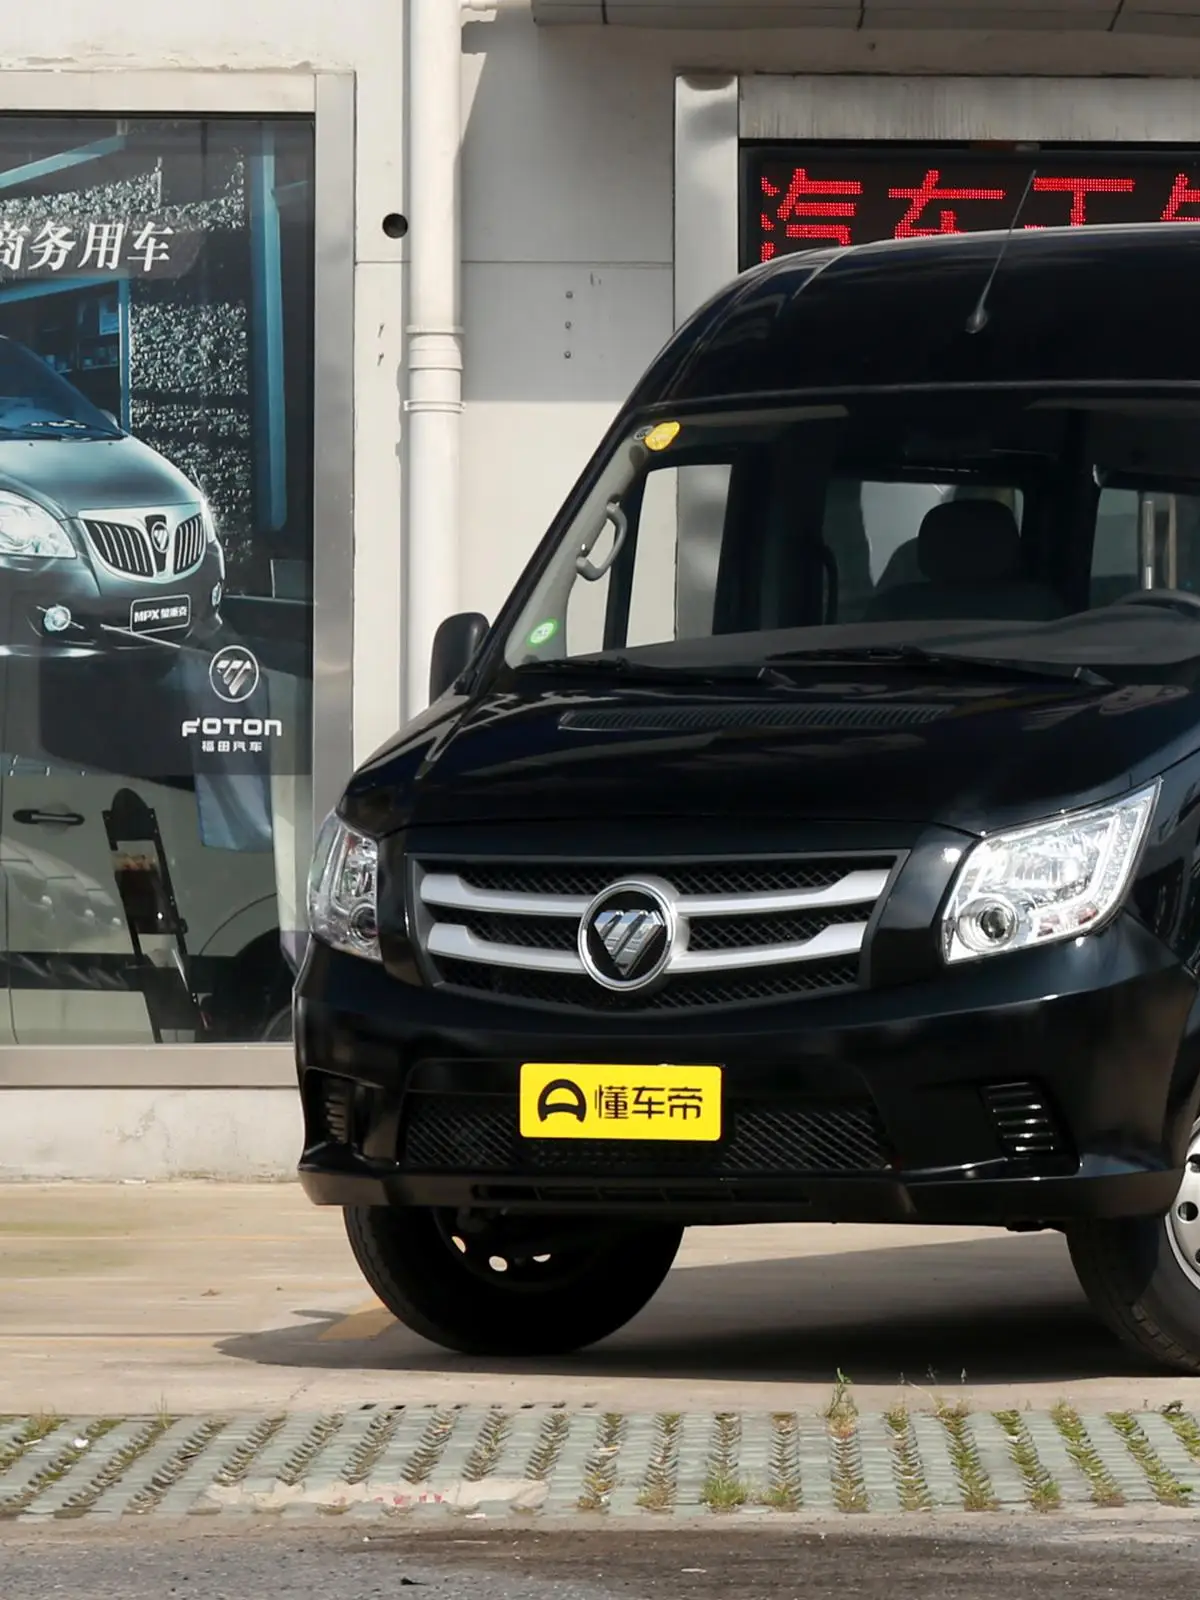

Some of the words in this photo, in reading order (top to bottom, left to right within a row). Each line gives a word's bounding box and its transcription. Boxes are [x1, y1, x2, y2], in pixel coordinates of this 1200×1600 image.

[0, 220, 174, 272] 商务用车
[134, 608, 160, 623] MPX
[181, 717, 283, 737] FOTON
[201, 740, 263, 753] 福田汽车
[595, 1084, 704, 1121] 懂车帝
